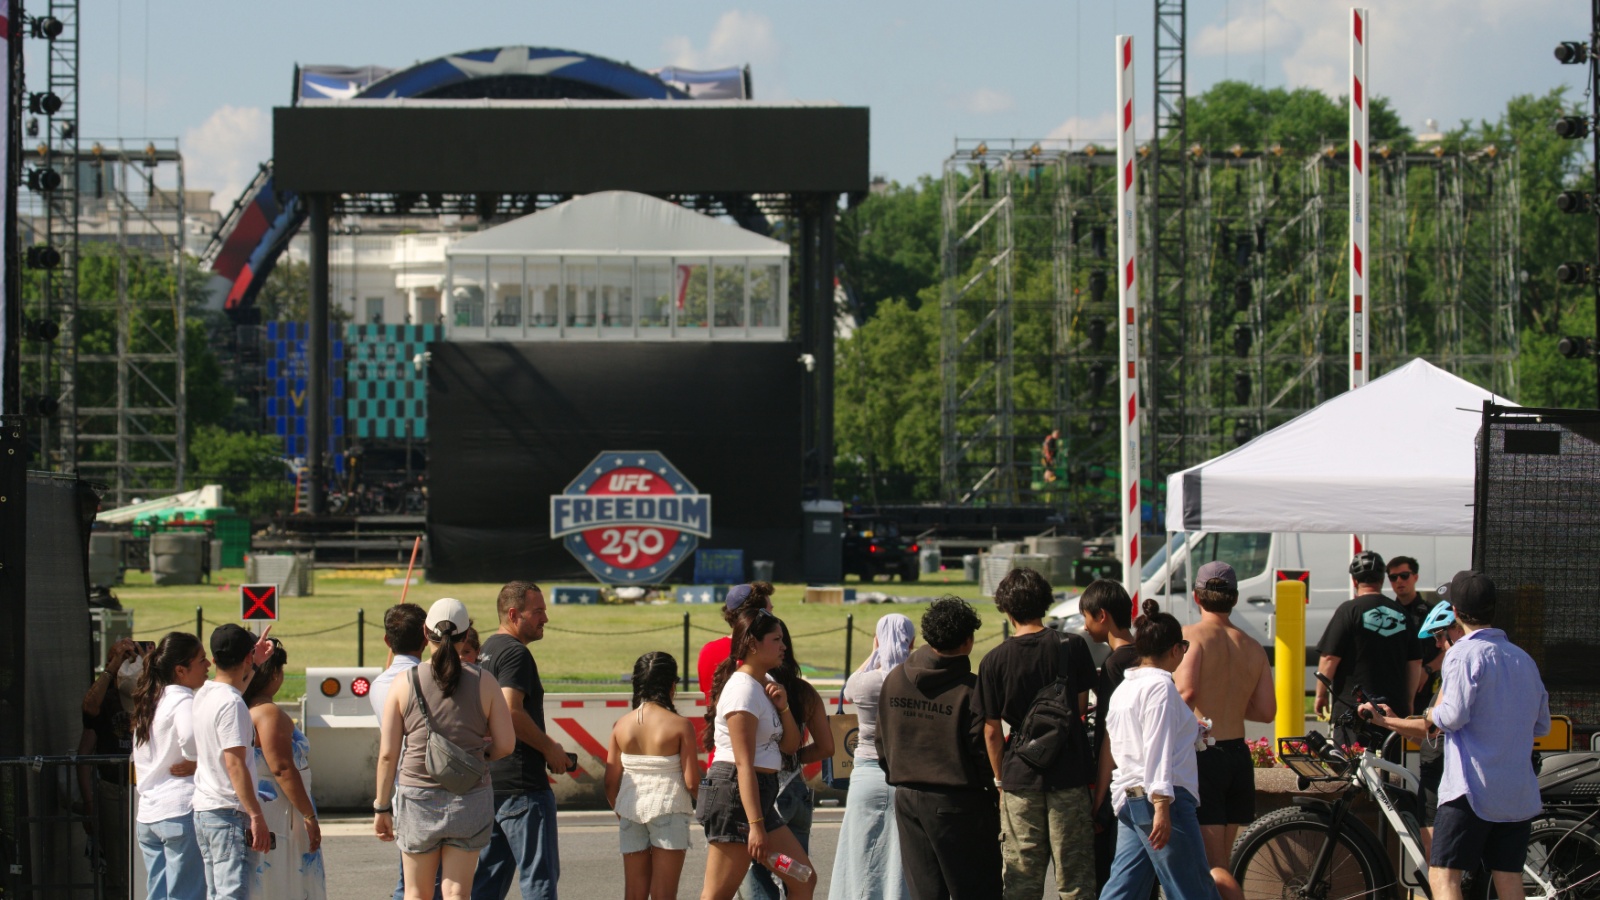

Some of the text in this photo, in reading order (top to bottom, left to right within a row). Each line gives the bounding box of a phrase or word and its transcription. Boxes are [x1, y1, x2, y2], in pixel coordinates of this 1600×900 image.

[608, 474, 653, 492] UFC
[554, 498, 708, 534] FREEDOM
[600, 529, 664, 564] 250
[889, 697, 953, 716] ESSENTIALS
[1266, 816, 1305, 829] KENDA
